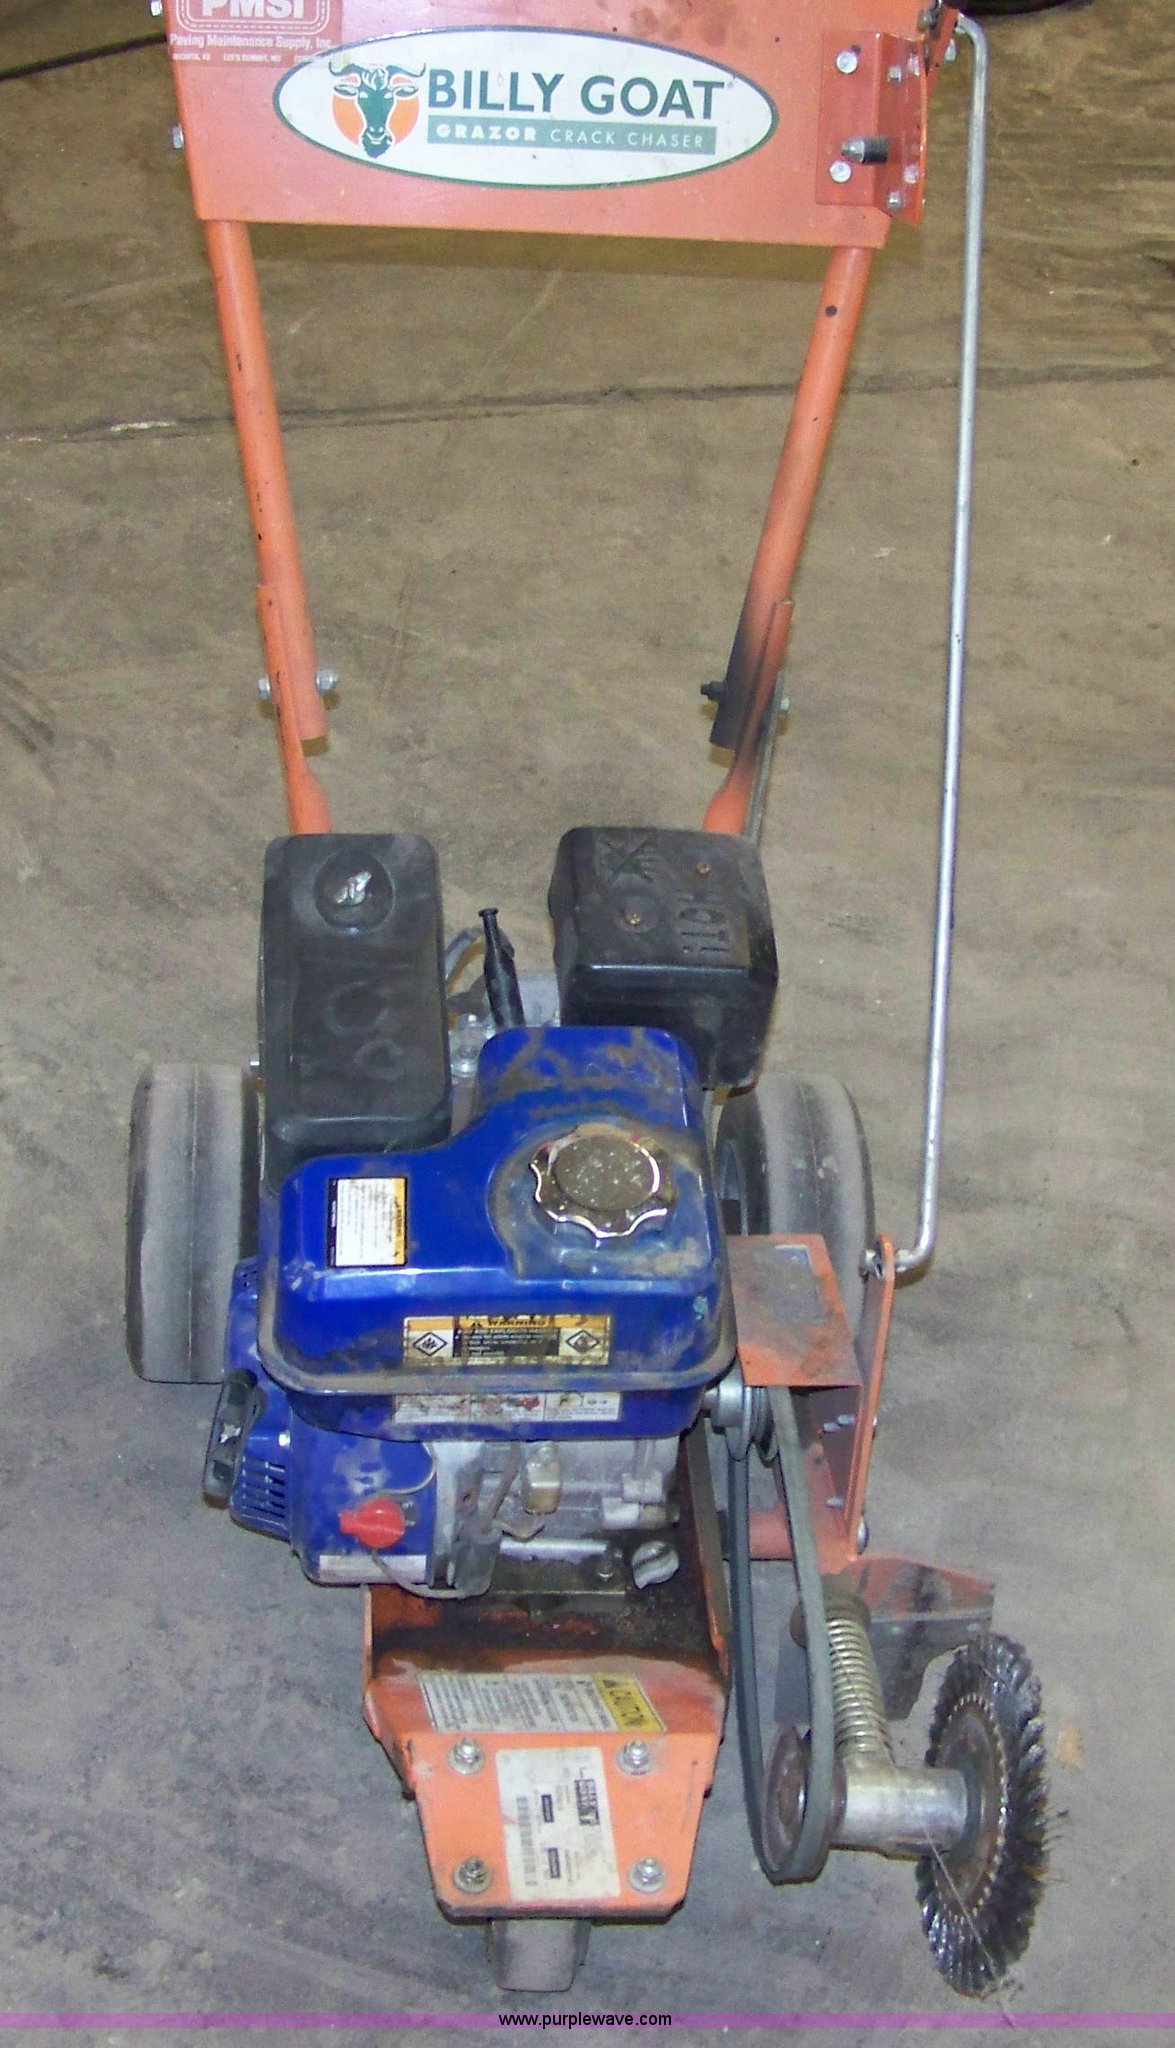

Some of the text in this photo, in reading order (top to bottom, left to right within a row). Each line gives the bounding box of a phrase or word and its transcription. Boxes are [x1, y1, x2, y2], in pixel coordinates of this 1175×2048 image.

[170, 33, 205, 48] Paving
[206, 35, 273, 47] Maintenance
[427, 68, 725, 120] BILLY GOAT
[436, 124, 705, 149] GRAZOR CRACK CHASER
